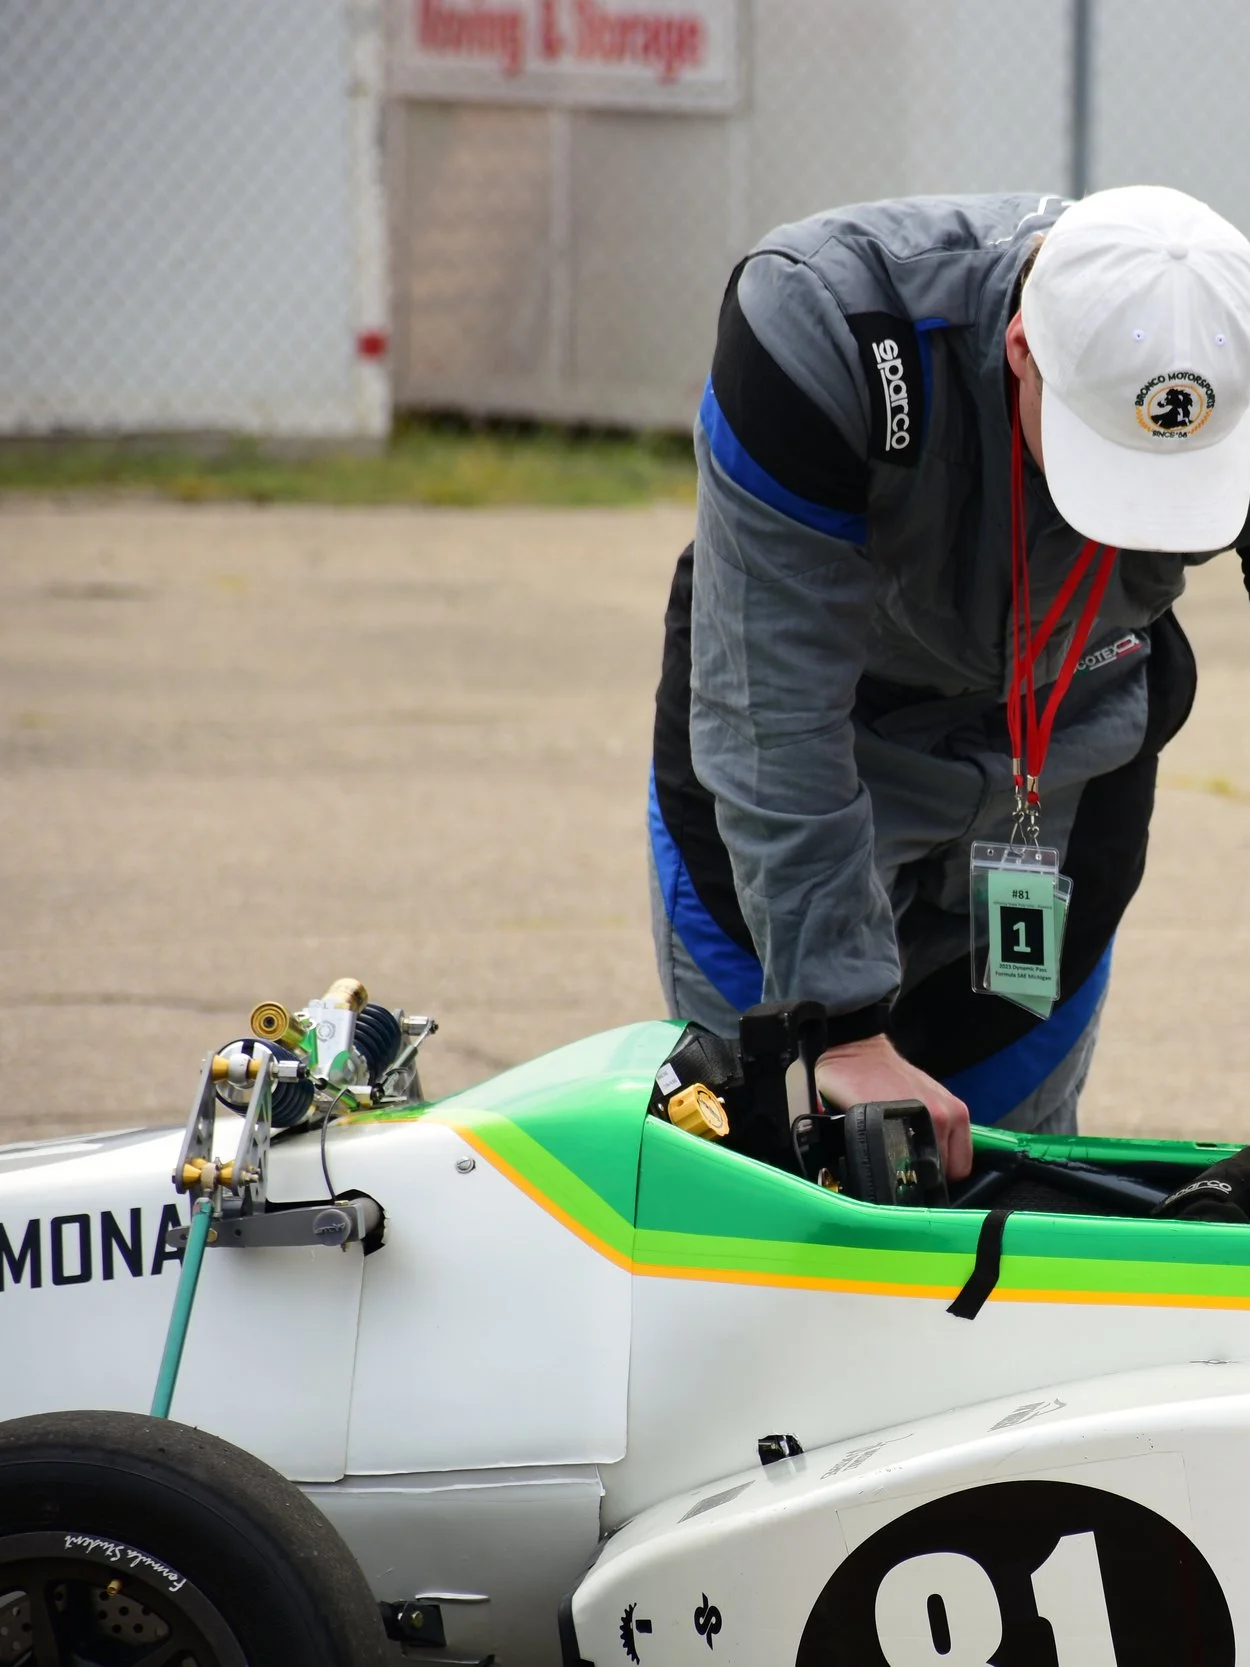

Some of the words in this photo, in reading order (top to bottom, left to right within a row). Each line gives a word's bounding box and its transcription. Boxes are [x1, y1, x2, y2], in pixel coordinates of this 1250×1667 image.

[872, 338, 910, 451] sparco
[1135, 375, 1165, 406] BRONCO
[1168, 372, 1216, 409] MOTORSPORTS
[1074, 633, 1140, 674] COTEX
[1012, 890, 1030, 900] #81
[1012, 921, 1031, 953] 1
[0, 1203, 184, 1293] MONA
[64, 1535, 124, 1561] Student
[127, 1549, 187, 1592] Formula
